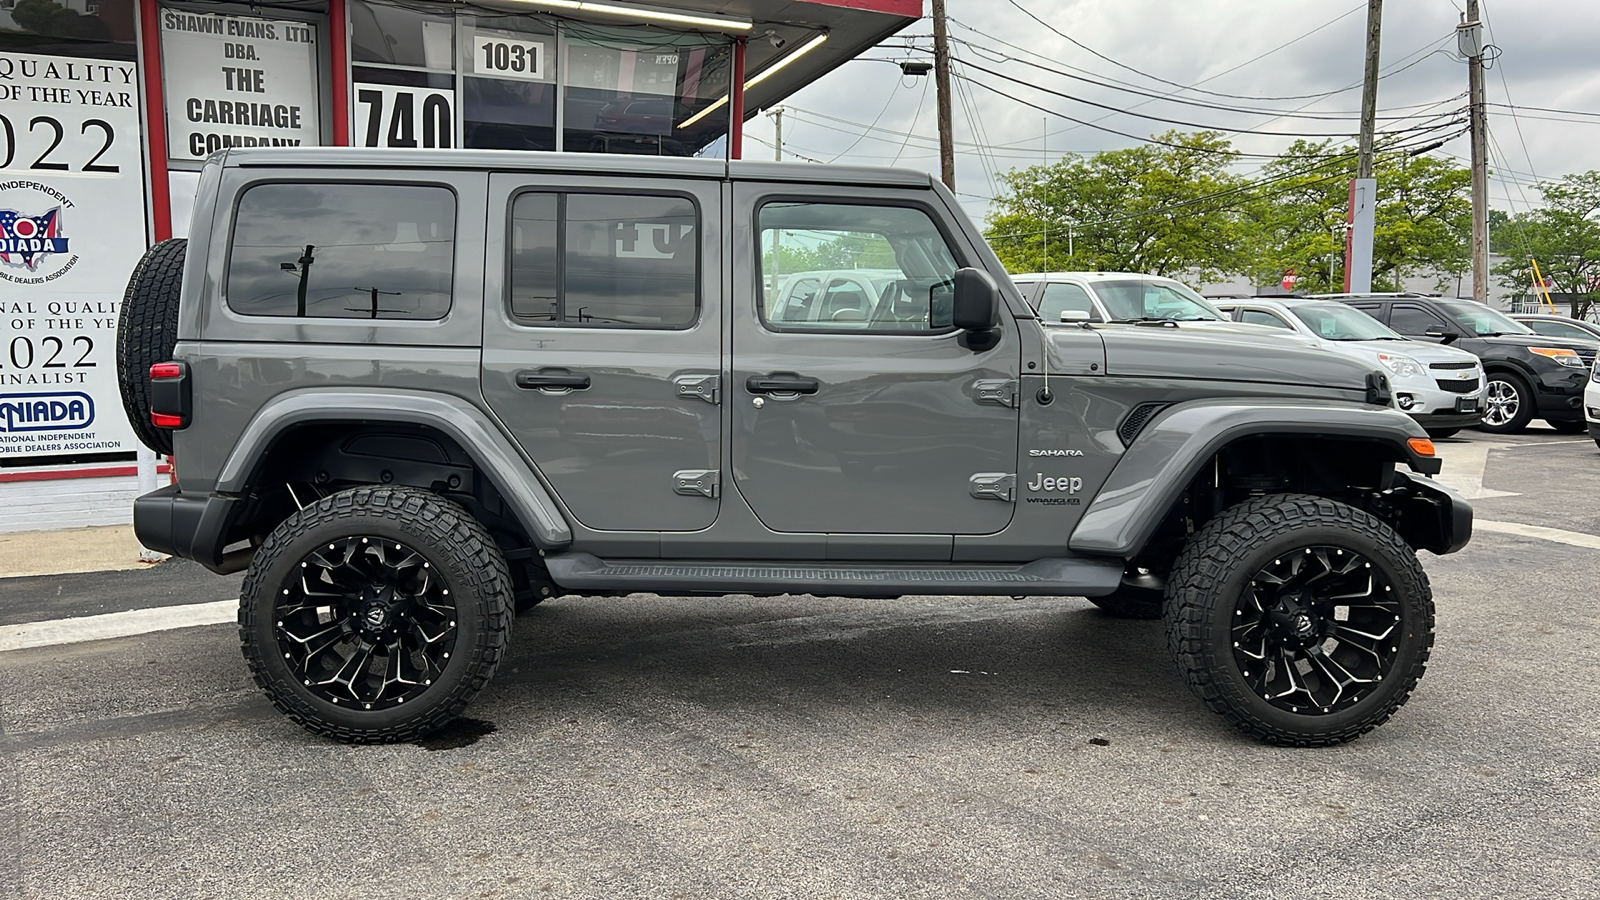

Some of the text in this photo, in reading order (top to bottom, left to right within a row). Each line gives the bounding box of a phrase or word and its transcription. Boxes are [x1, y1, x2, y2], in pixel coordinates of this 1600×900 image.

[165, 13, 223, 35] SHAWN
[286, 26, 314, 44] LTD.
[225, 42, 260, 61] DBA.
[482, 42, 537, 73] 1031
[0, 58, 134, 84] QUALITY
[222, 66, 265, 93] THE
[0, 84, 132, 108] OF THE YEAR
[186, 98, 302, 129] CARRIAGE
[358, 88, 452, 148] 740
[14, 276, 45, 285] DEALERS
[45, 254, 79, 282] ASSOCIATION
[48, 302, 122, 316] QUALI
[11, 318, 115, 330] OF THE YE
[0, 336, 97, 369] 022
[25, 443, 61, 452] DEALERS
[64, 441, 121, 450] ASSOCIATION
[38, 432, 96, 442] INDEPENDENT
[1029, 449, 1084, 457] SAHARA
[1027, 472, 1083, 495] Jeep
